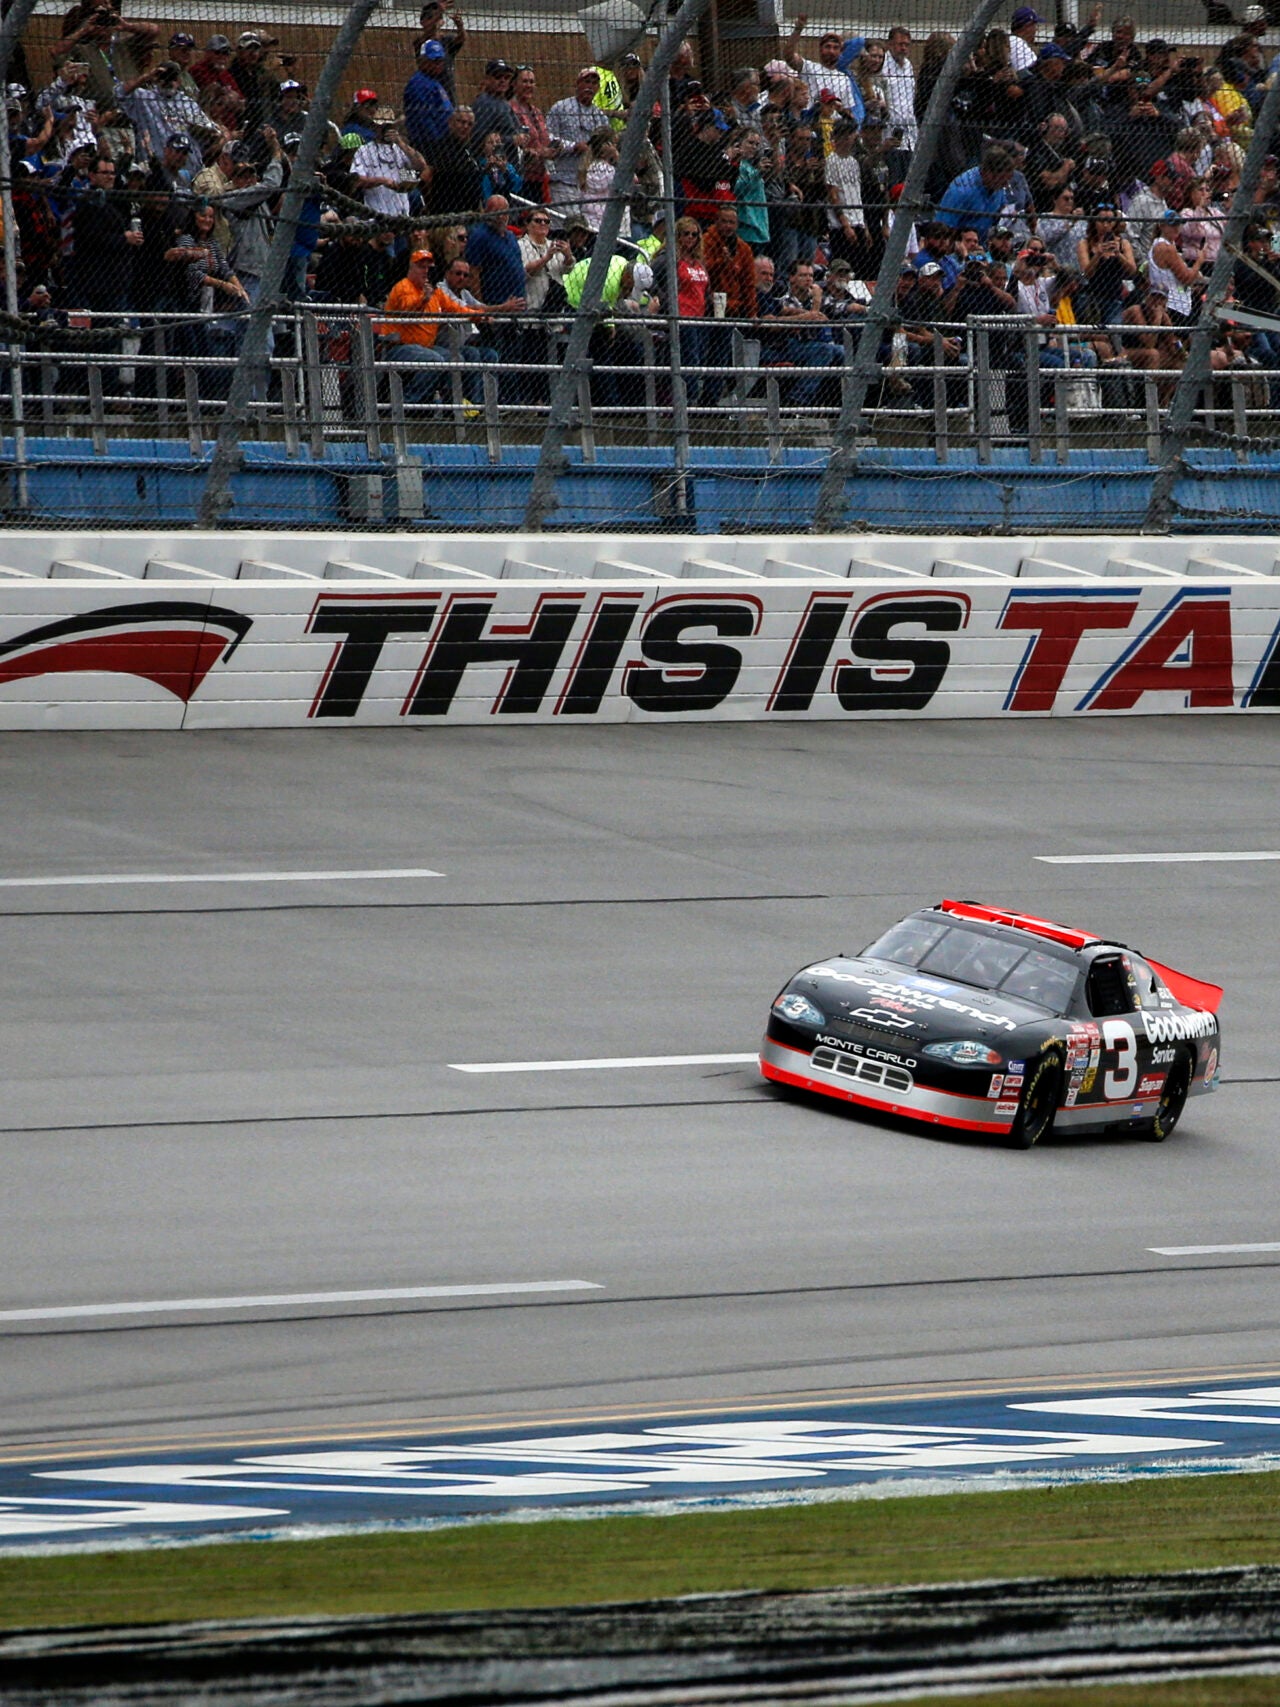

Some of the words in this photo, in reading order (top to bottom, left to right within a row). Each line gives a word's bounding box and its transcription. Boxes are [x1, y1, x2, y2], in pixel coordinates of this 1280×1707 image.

[308, 591, 763, 717] THIS
[765, 589, 971, 711] IS
[790, 1002, 809, 1015] 3
[805, 967, 1017, 1031] Goodwrench
[1141, 1010, 1218, 1043] Goodwrench
[815, 1033, 864, 1055] MONTE
[865, 1047, 918, 1069] CARLO
[1102, 1020, 1138, 1100] 3
[1151, 1045, 1176, 1065] Service
